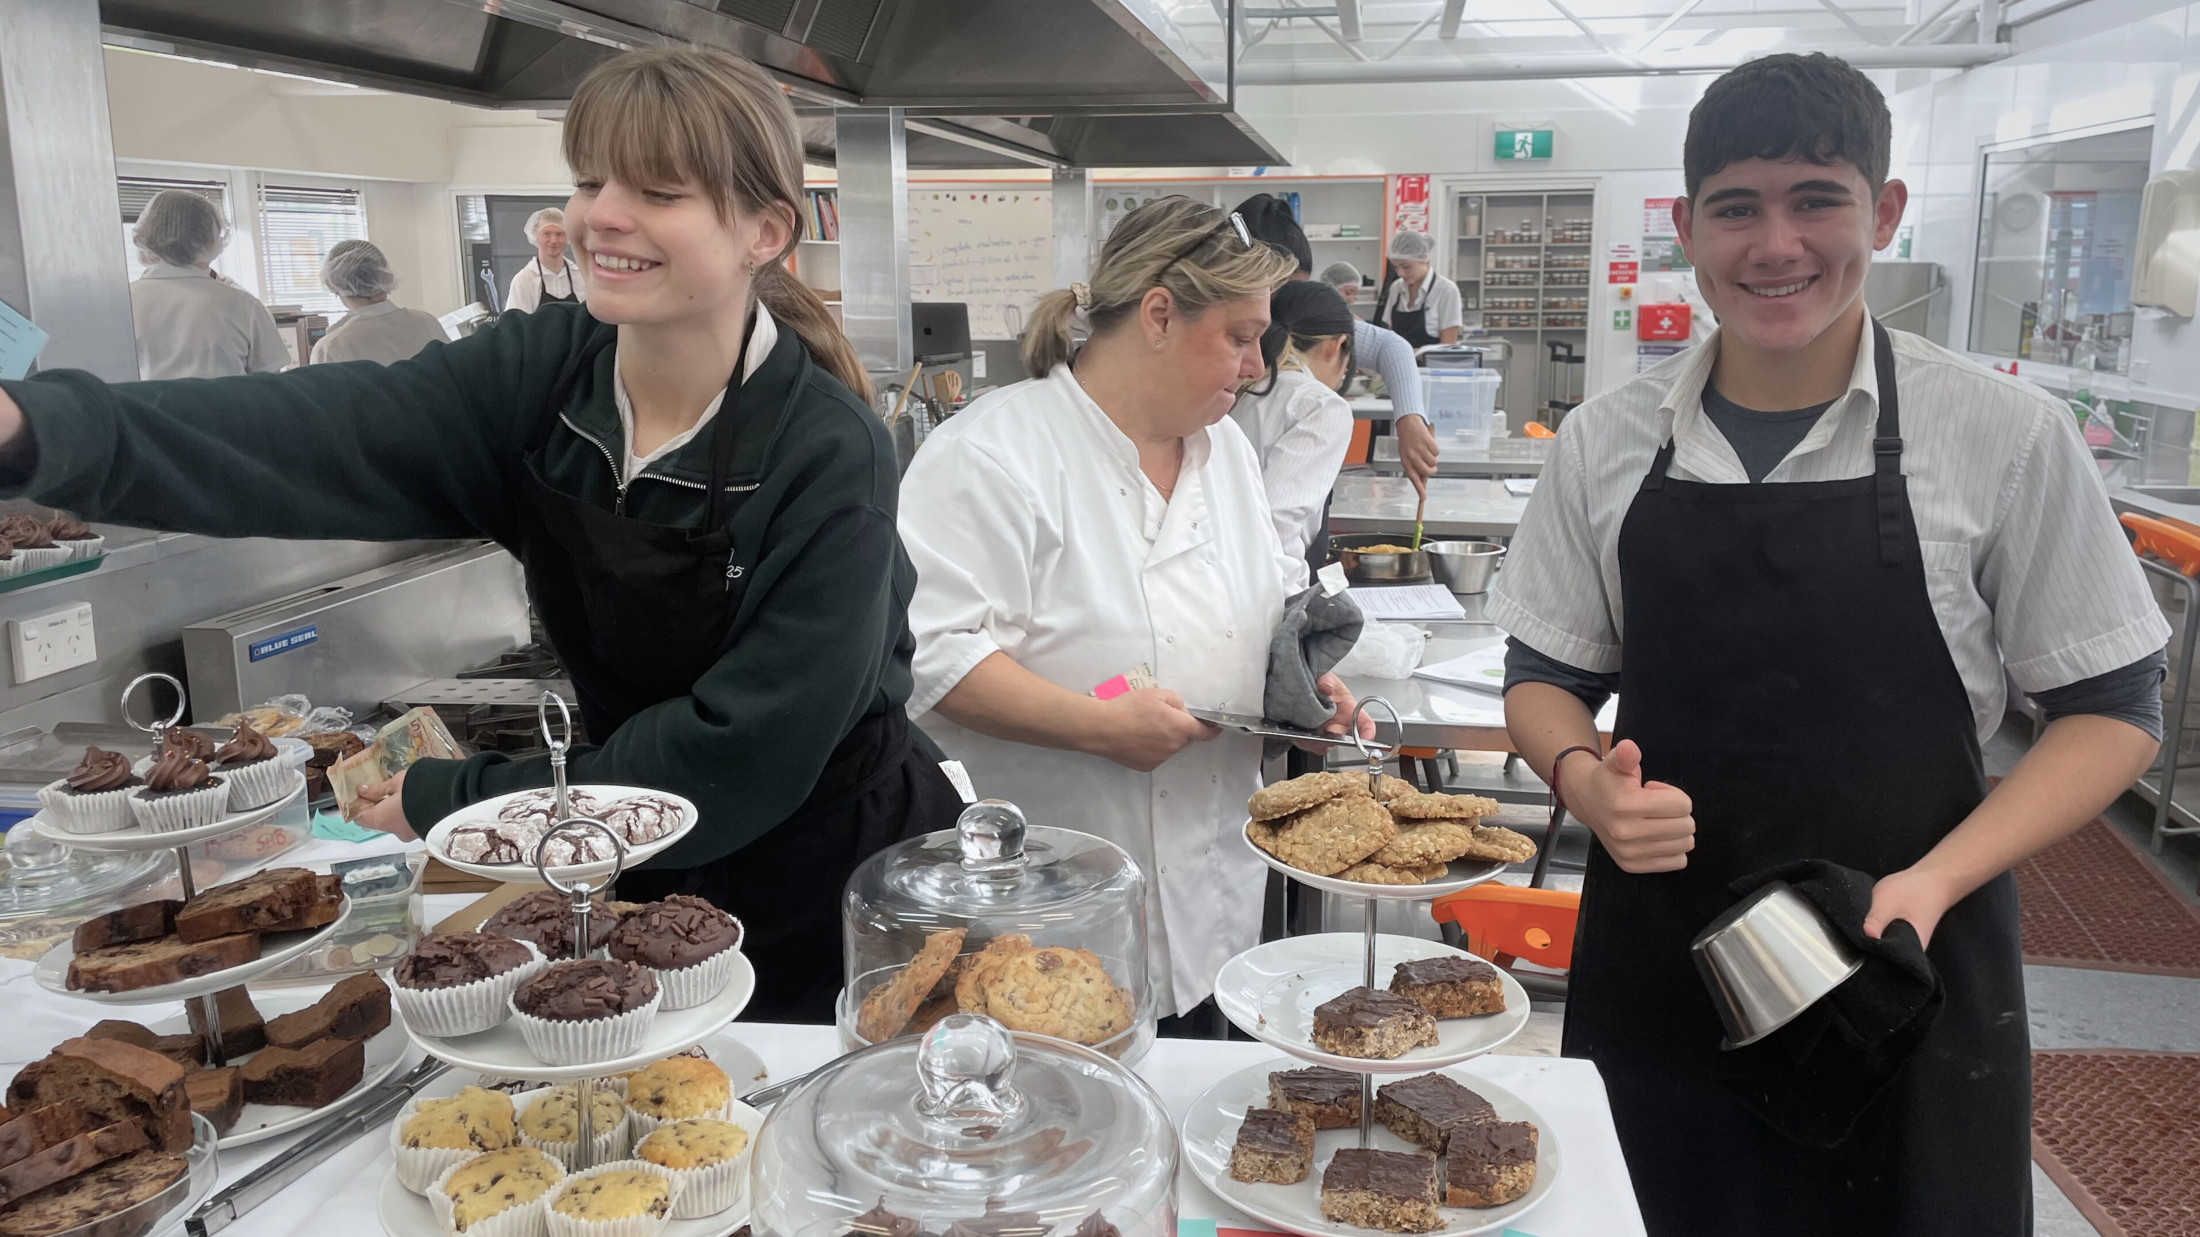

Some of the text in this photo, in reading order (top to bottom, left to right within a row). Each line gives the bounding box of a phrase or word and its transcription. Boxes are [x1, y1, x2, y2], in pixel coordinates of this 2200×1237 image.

[726, 565, 745, 578] 25
[260, 630, 318, 655] BLUE SEAL
